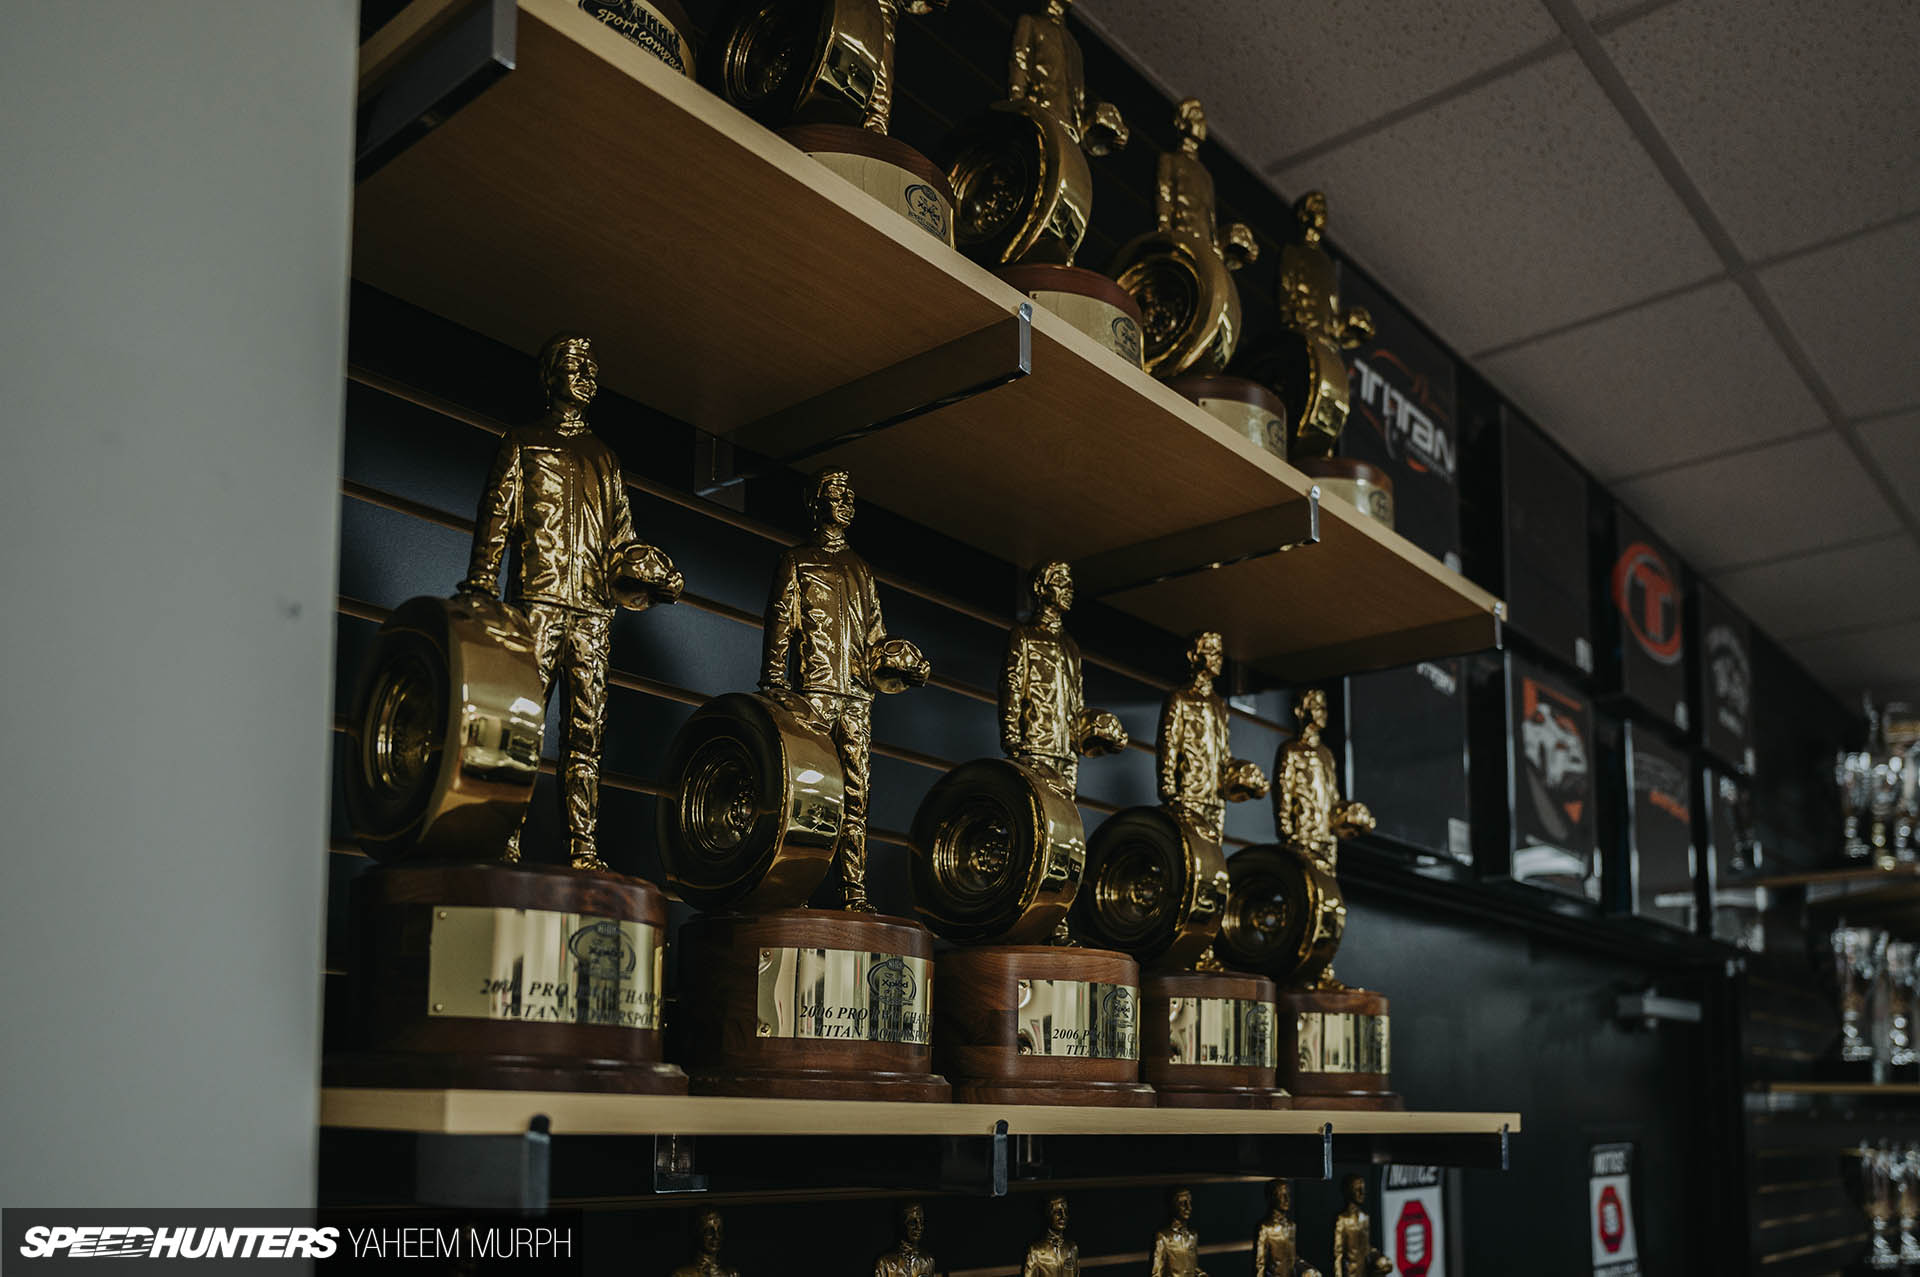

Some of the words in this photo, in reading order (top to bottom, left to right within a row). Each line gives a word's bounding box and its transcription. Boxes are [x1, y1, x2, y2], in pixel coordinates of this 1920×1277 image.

[529, 981, 569, 998] PRO
[502, 1003, 560, 1020] TTAN
[800, 1005, 833, 1019] 2006
[837, 1006, 868, 1021] PRO
[816, 1024, 863, 1038] TITAN
[1052, 1028, 1079, 1040] 2006
[1082, 1029, 1106, 1042] PO
